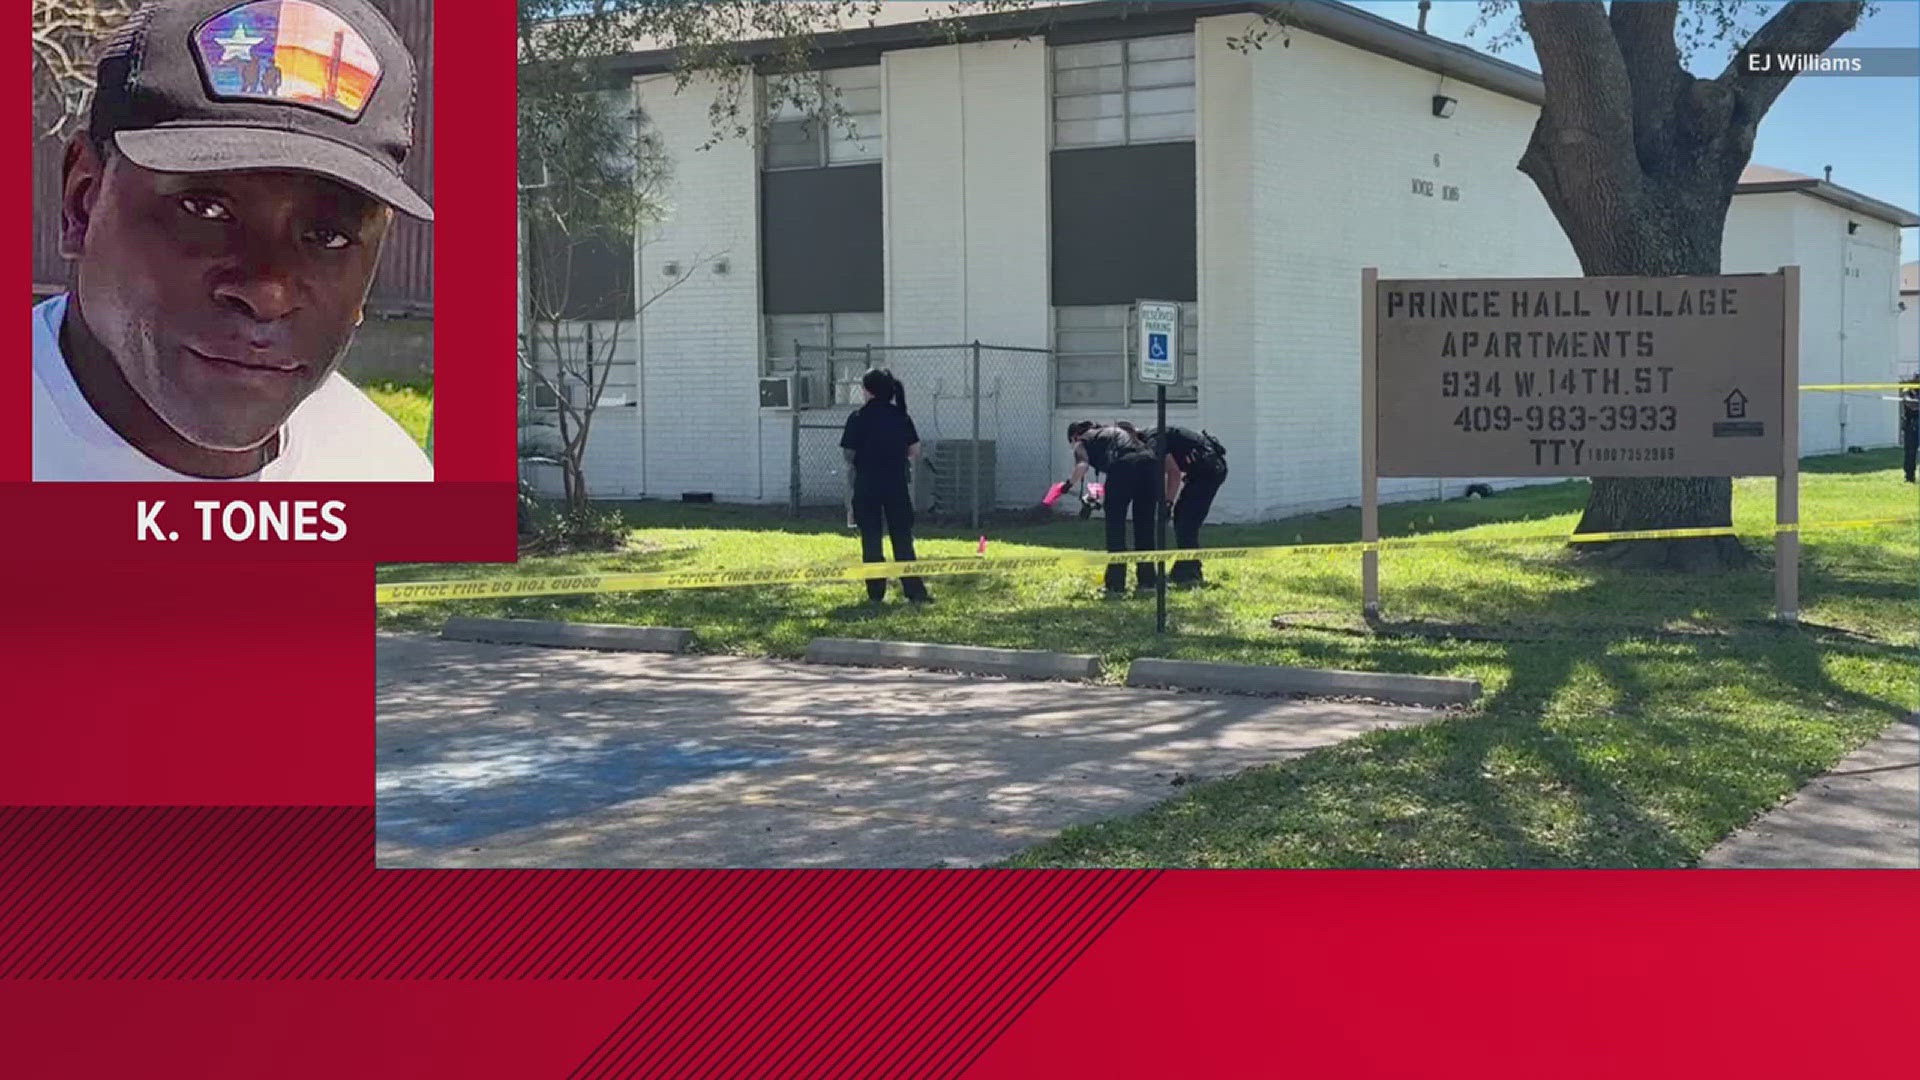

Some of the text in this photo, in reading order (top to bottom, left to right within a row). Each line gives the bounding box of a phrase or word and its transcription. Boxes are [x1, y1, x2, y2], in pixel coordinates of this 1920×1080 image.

[1387, 288, 1738, 319] PRINCE HALL VILLAGE
[1441, 331, 1654, 358] APARTMENTS
[1442, 371, 1501, 397] 934
[1453, 405, 1677, 432] 409-983-3933
[1530, 439, 1585, 465] TTY
